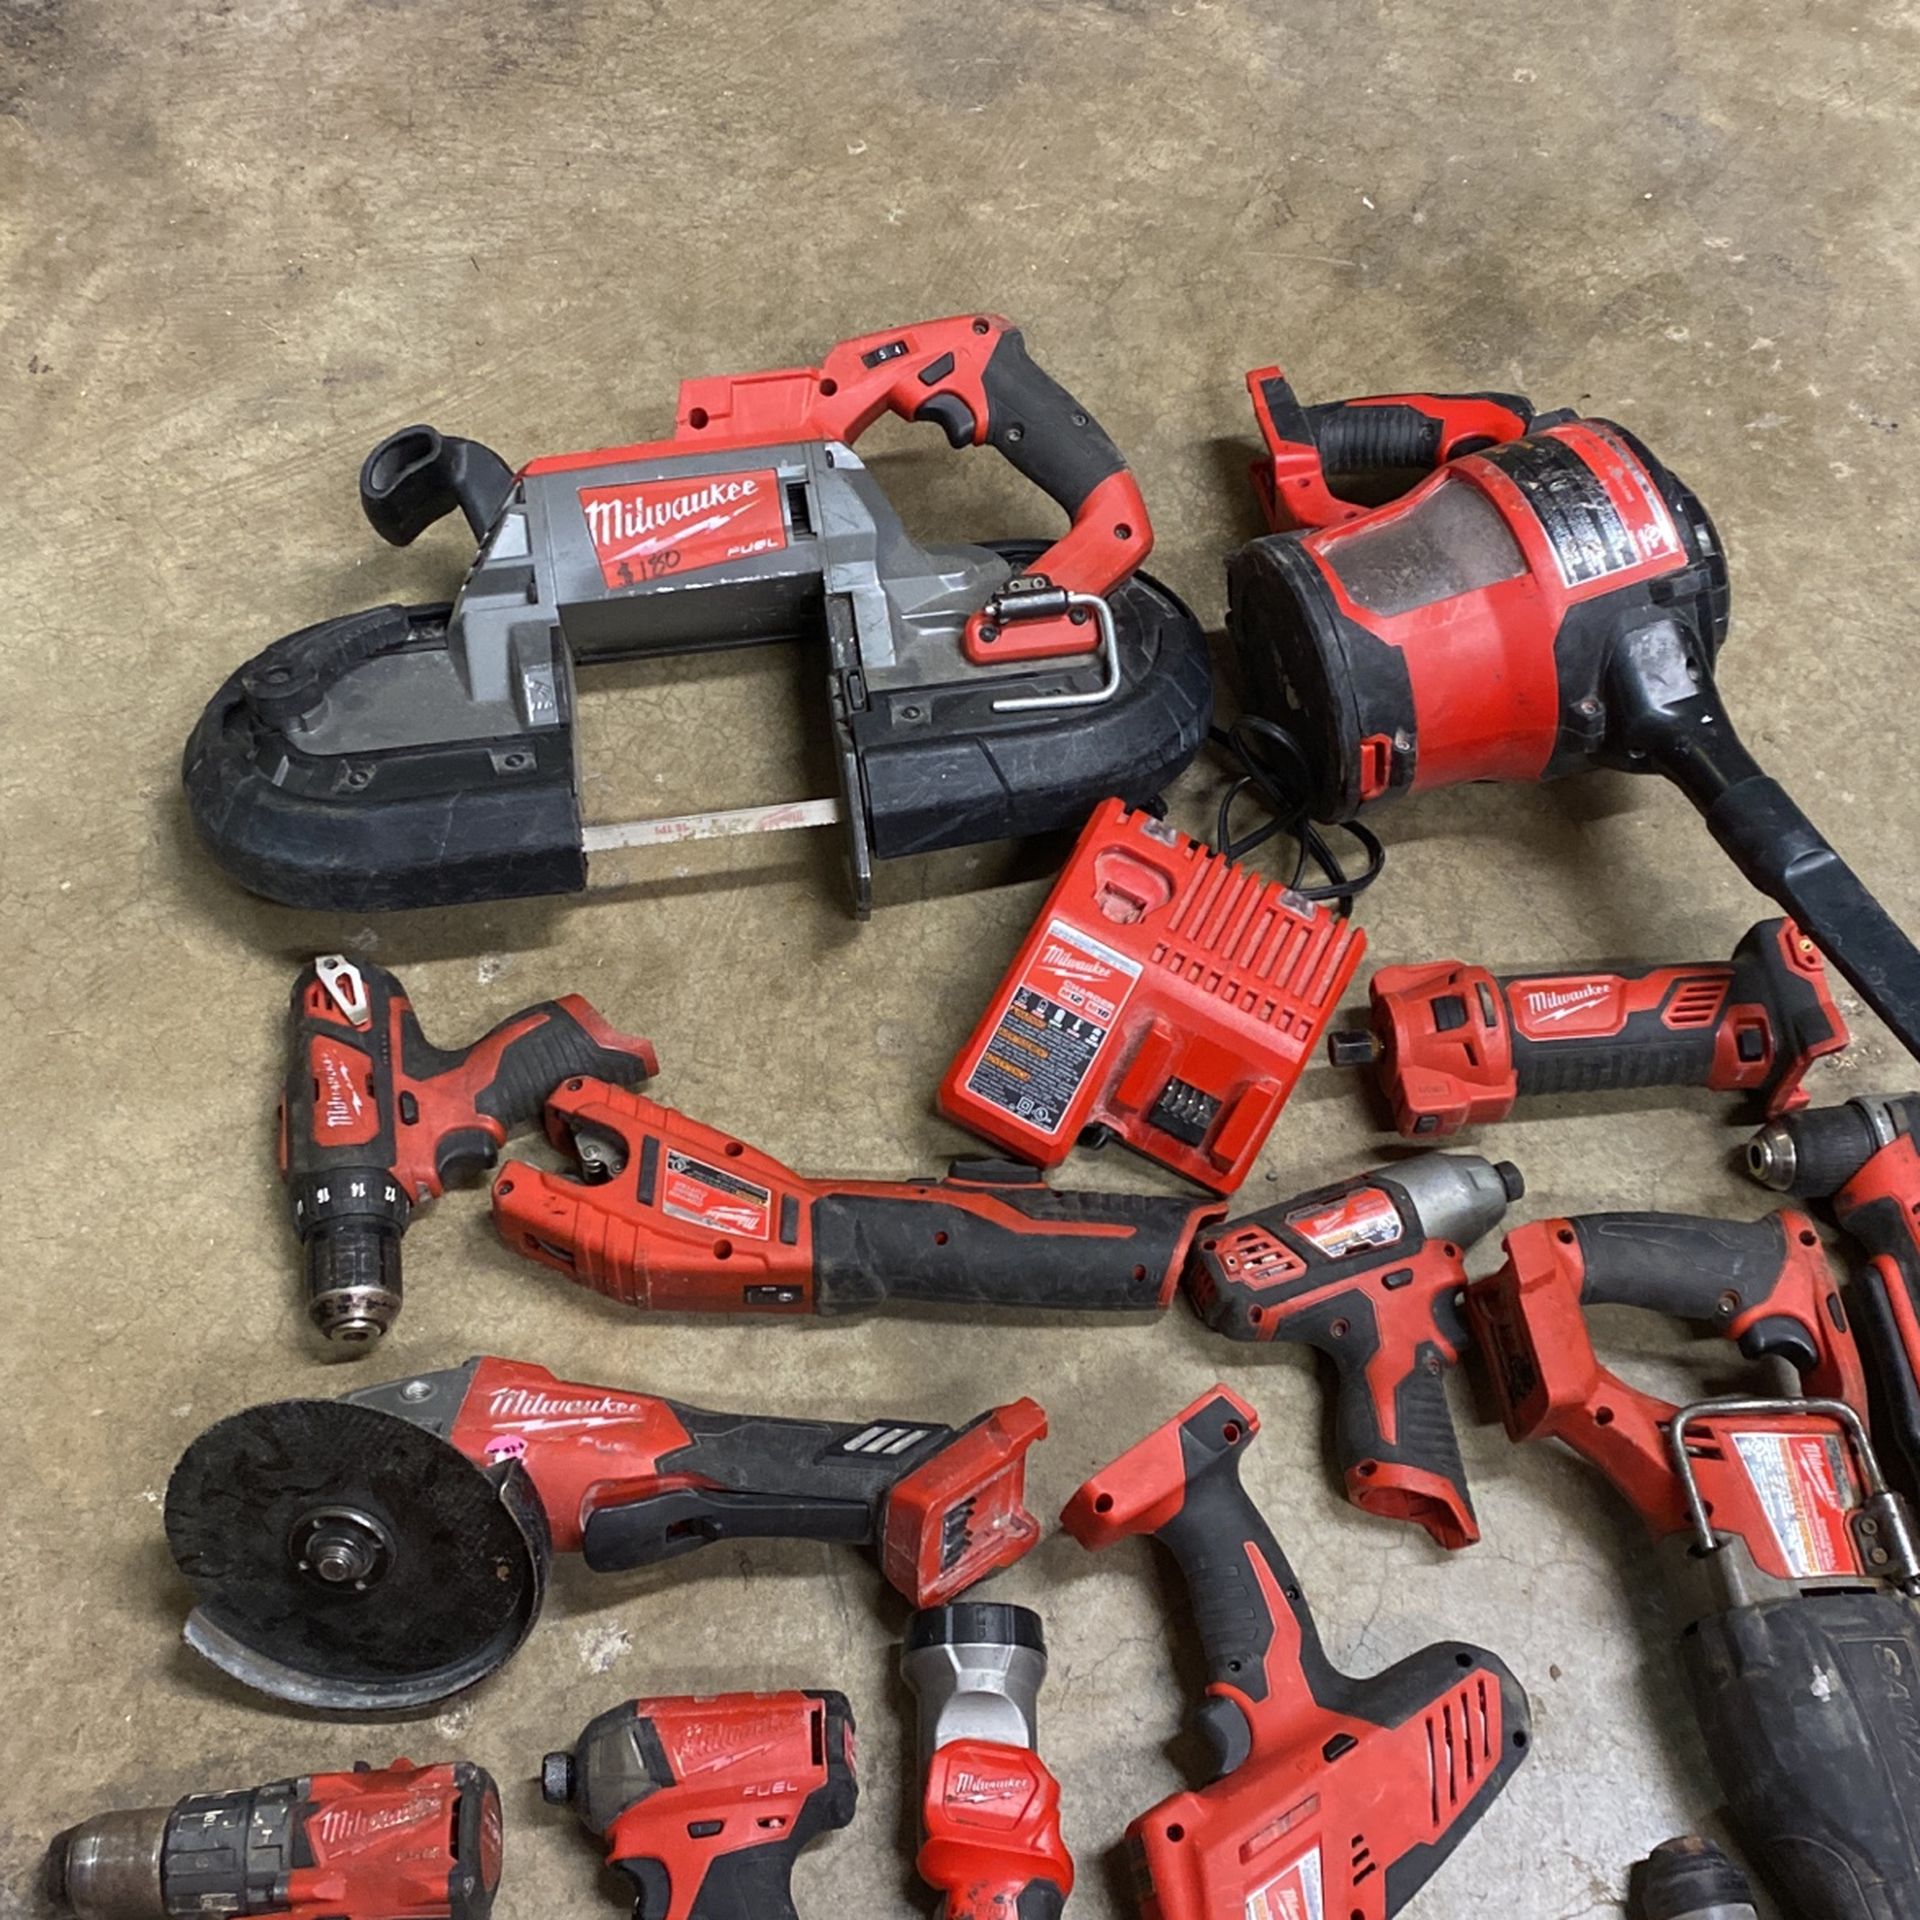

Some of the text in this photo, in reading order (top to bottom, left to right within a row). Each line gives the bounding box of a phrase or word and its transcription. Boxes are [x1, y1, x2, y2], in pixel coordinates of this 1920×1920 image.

[584, 479, 759, 546] Milwaukee
[727, 538, 779, 557] FUEL
[1042, 943, 1112, 978] Milwaukee
[1523, 983, 1610, 1015] Milwaukee
[489, 1386, 642, 1416] Milwaukee
[742, 1780, 798, 1797] FUEL
[956, 1772, 1028, 1794] Milwaukee
